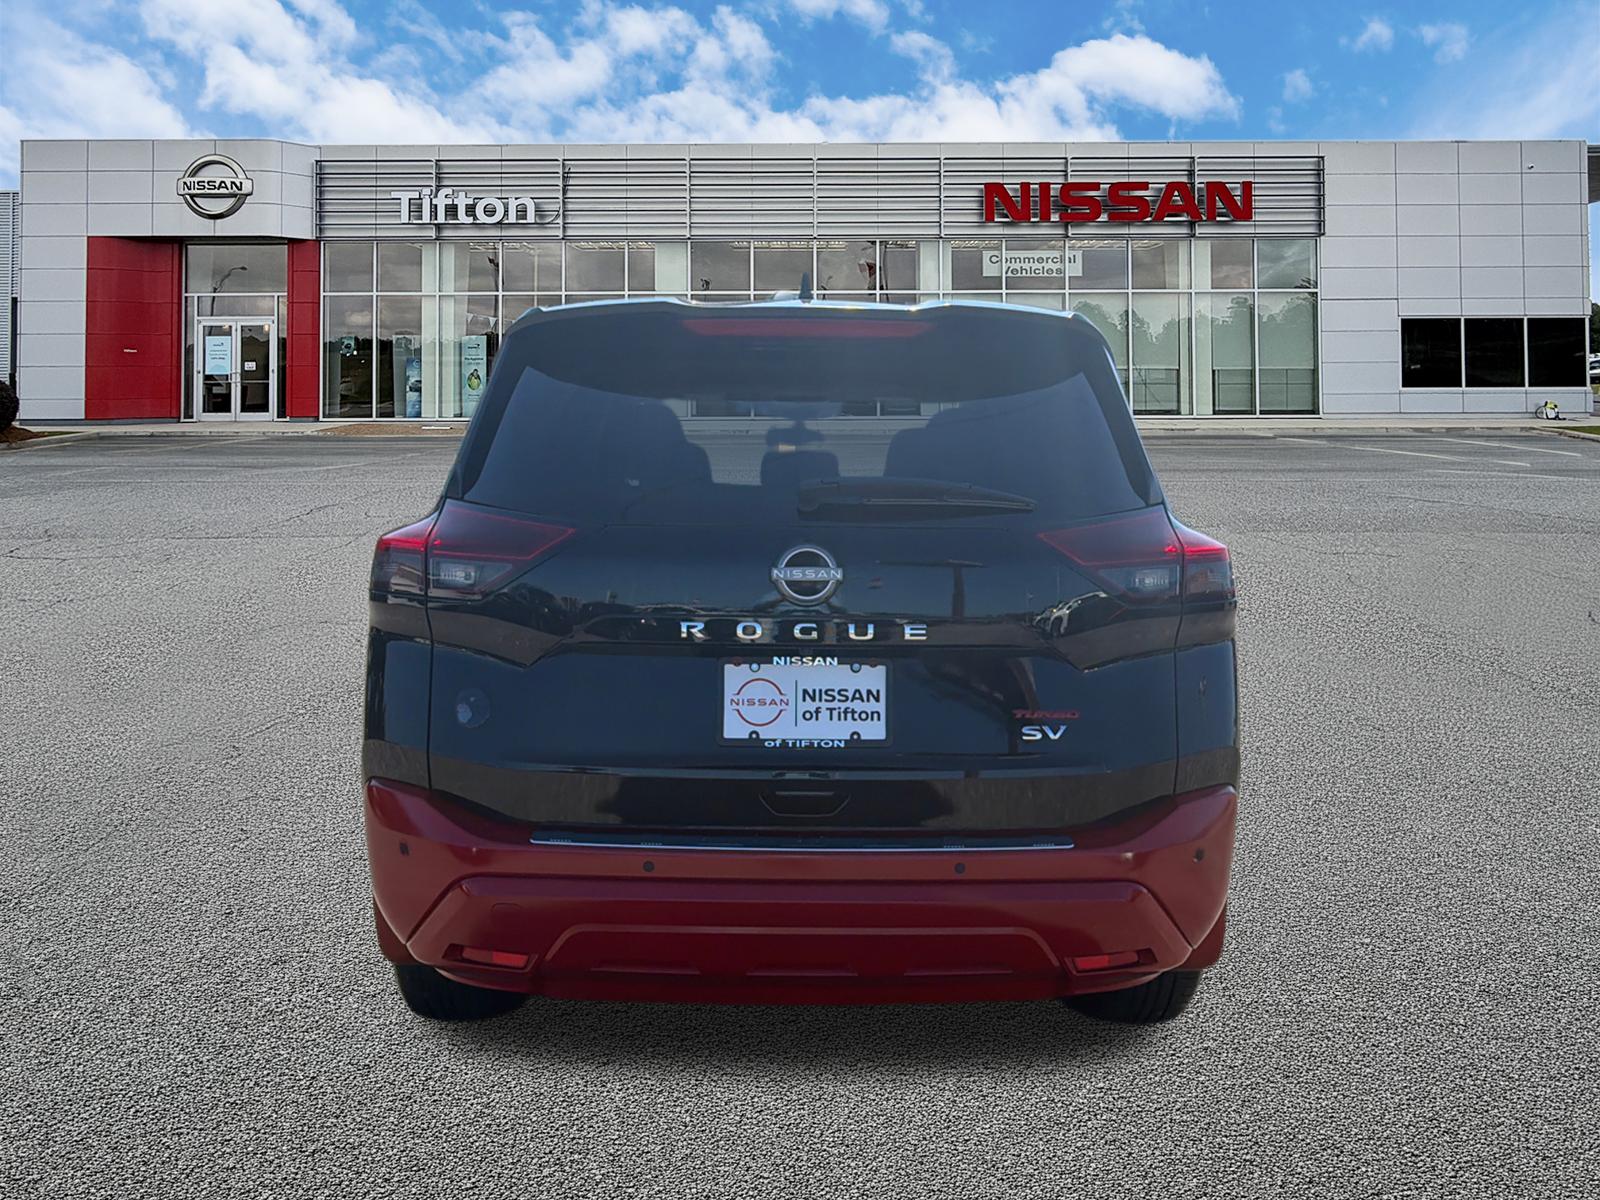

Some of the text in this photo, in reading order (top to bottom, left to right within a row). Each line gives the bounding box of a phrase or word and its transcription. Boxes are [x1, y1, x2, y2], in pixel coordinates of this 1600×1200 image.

[182, 180, 244, 192] NISSAN
[391, 188, 536, 224] Tifton
[983, 181, 1254, 222] NISSAN
[773, 568, 843, 580] NISSAN
[680, 621, 927, 640] ROGUE
[773, 656, 838, 667] NISSAN
[730, 698, 789, 707] NISSAN
[802, 688, 880, 703] NISSAN
[802, 706, 881, 721] of Tifton
[1021, 724, 1067, 740] SV
[764, 739, 846, 749] of TIFTON
